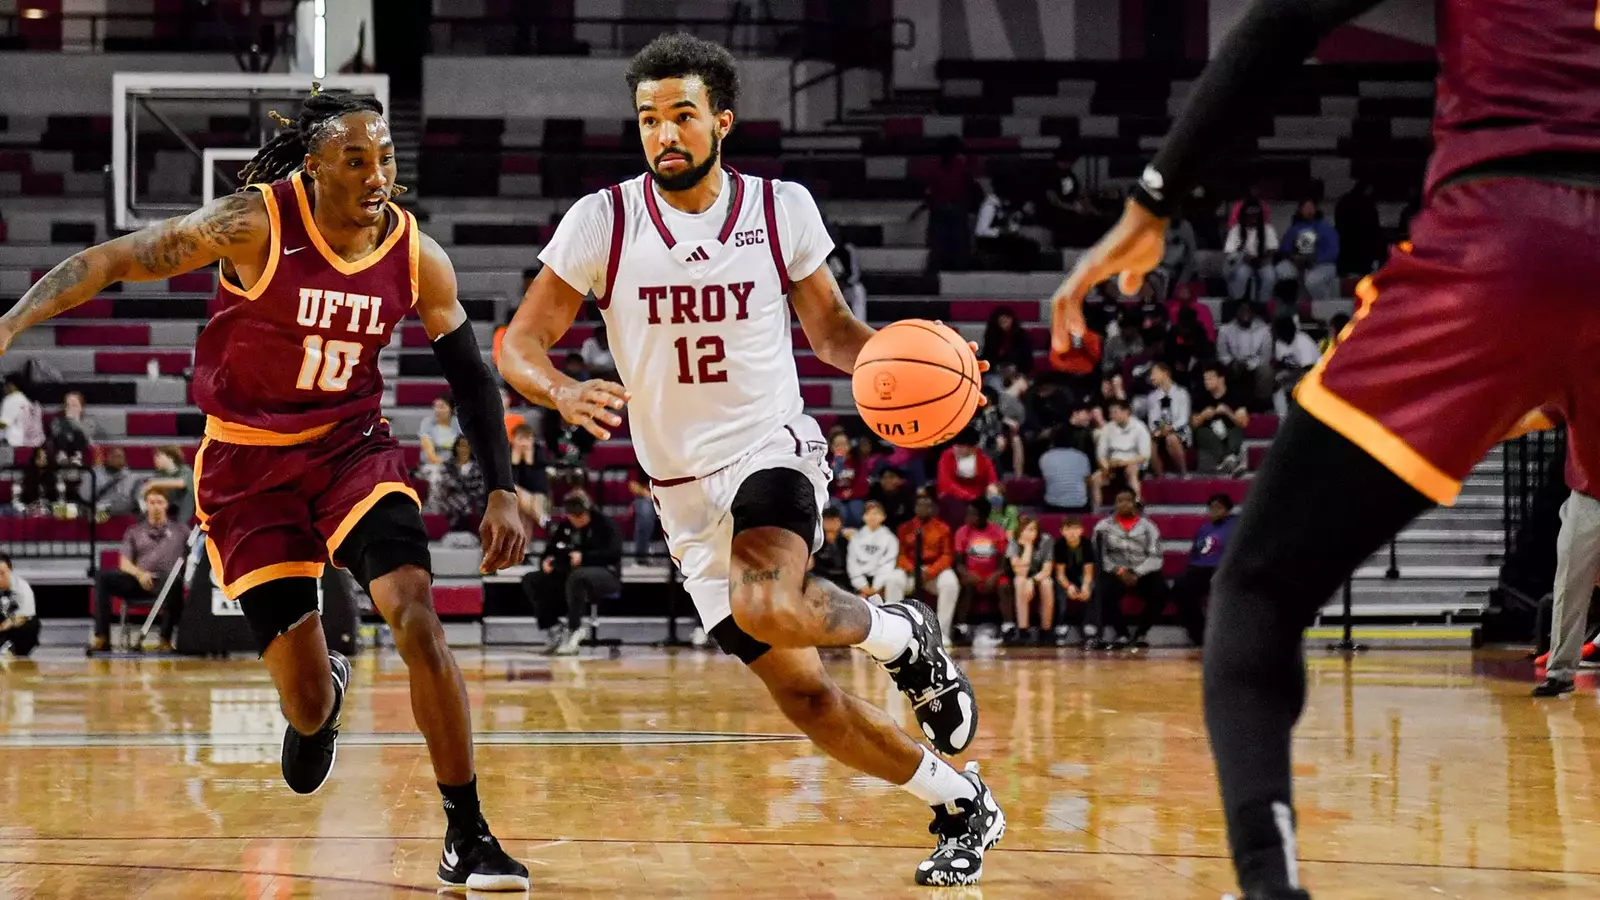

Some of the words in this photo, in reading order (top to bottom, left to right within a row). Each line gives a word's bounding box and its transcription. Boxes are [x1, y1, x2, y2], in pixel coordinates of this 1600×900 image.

[296, 288, 386, 335] UFTL
[638, 281, 755, 325] TROY
[296, 334, 364, 392] 10
[674, 335, 728, 384] 12
